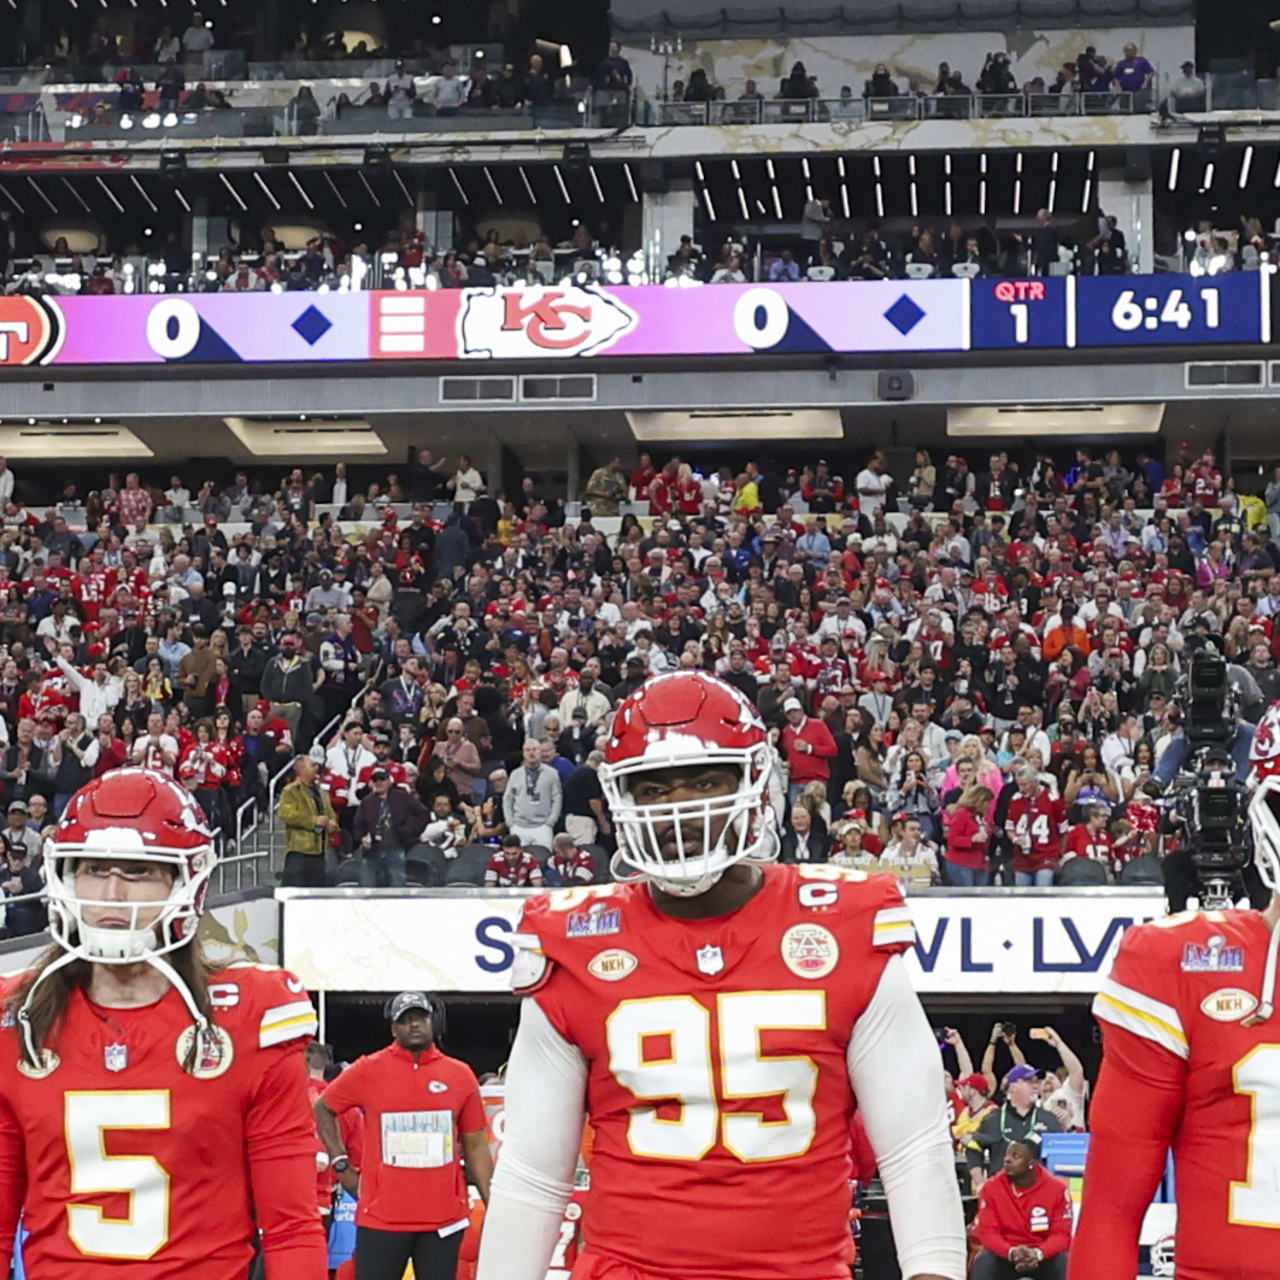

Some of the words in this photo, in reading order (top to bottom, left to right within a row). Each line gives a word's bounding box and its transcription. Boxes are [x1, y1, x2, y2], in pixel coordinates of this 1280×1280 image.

[994, 280, 1046, 302] QTR
[1111, 287, 1221, 330] 6:41
[147, 298, 201, 358] 0
[732, 288, 790, 348] 0
[1009, 304, 1029, 344] 1
[1016, 813, 1049, 844] 44
[600, 958, 626, 973] NKH
[1215, 998, 1242, 1012] NKH
[605, 989, 828, 1164] 95
[63, 1088, 172, 1261] 5
